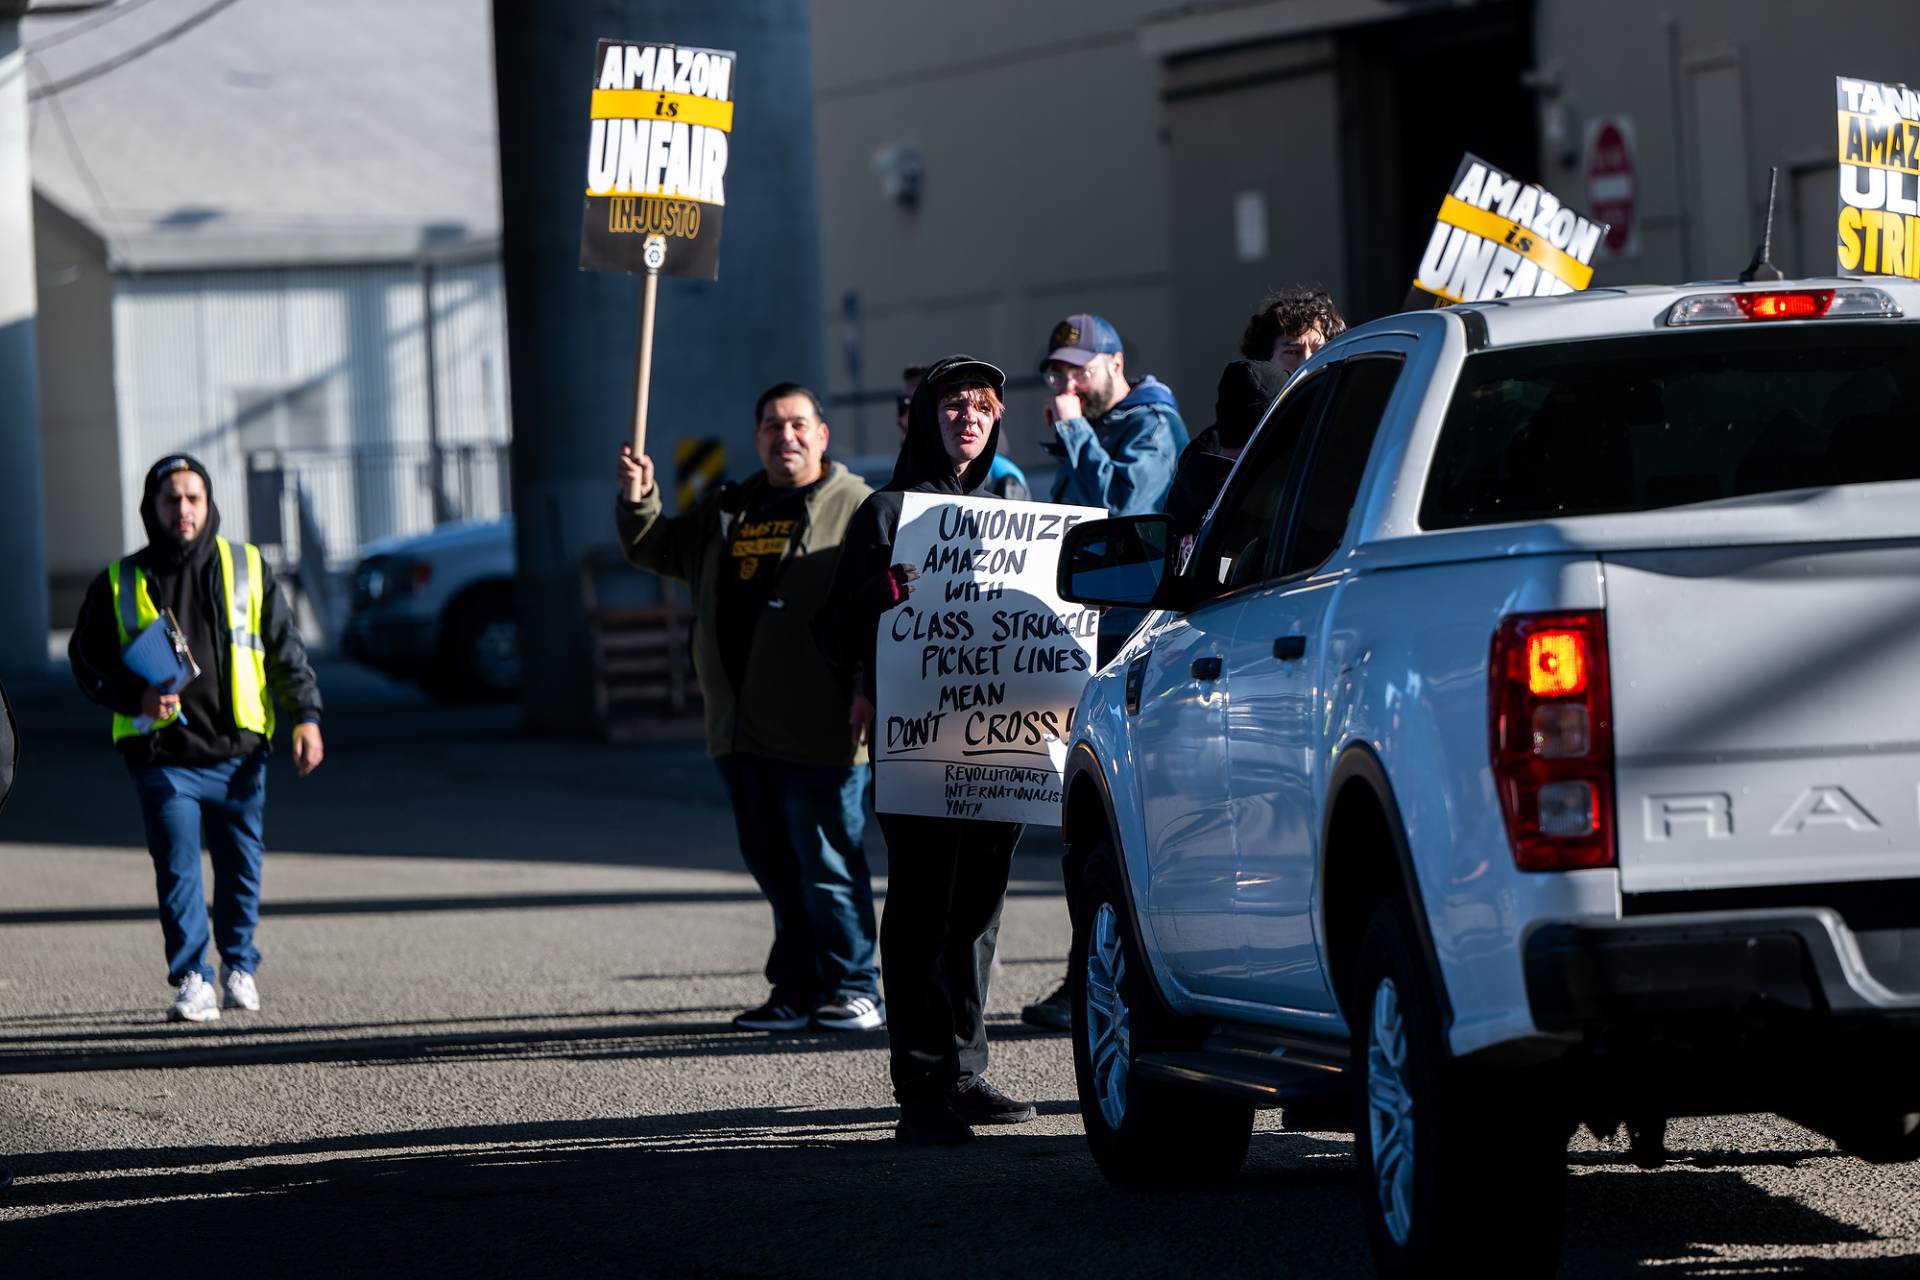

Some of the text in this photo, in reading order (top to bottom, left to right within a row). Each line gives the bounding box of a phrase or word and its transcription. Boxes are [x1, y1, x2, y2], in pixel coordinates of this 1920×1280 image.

[599, 46, 731, 101] AMAZON
[655, 94, 679, 117] is
[587, 119, 728, 206] UNFAIR
[1840, 163, 1920, 217] UL
[609, 197, 700, 239] INJUSTO
[1454, 162, 1601, 265] AMAZON
[1505, 220, 1533, 252] is
[1418, 219, 1575, 300] UNFA
[938, 505, 1082, 541] UNIONIZE
[922, 544, 1028, 575] AMAZON
[945, 580, 1004, 603] WITH
[891, 606, 1097, 642] CLASS STRUGGLE
[922, 644, 1088, 680] PICKET LINES
[938, 681, 1006, 712] MEAN
[944, 764, 1050, 787] REVOLUTIONARY
[946, 800, 983, 816] YOUTH
[1643, 783, 1920, 842] RA
